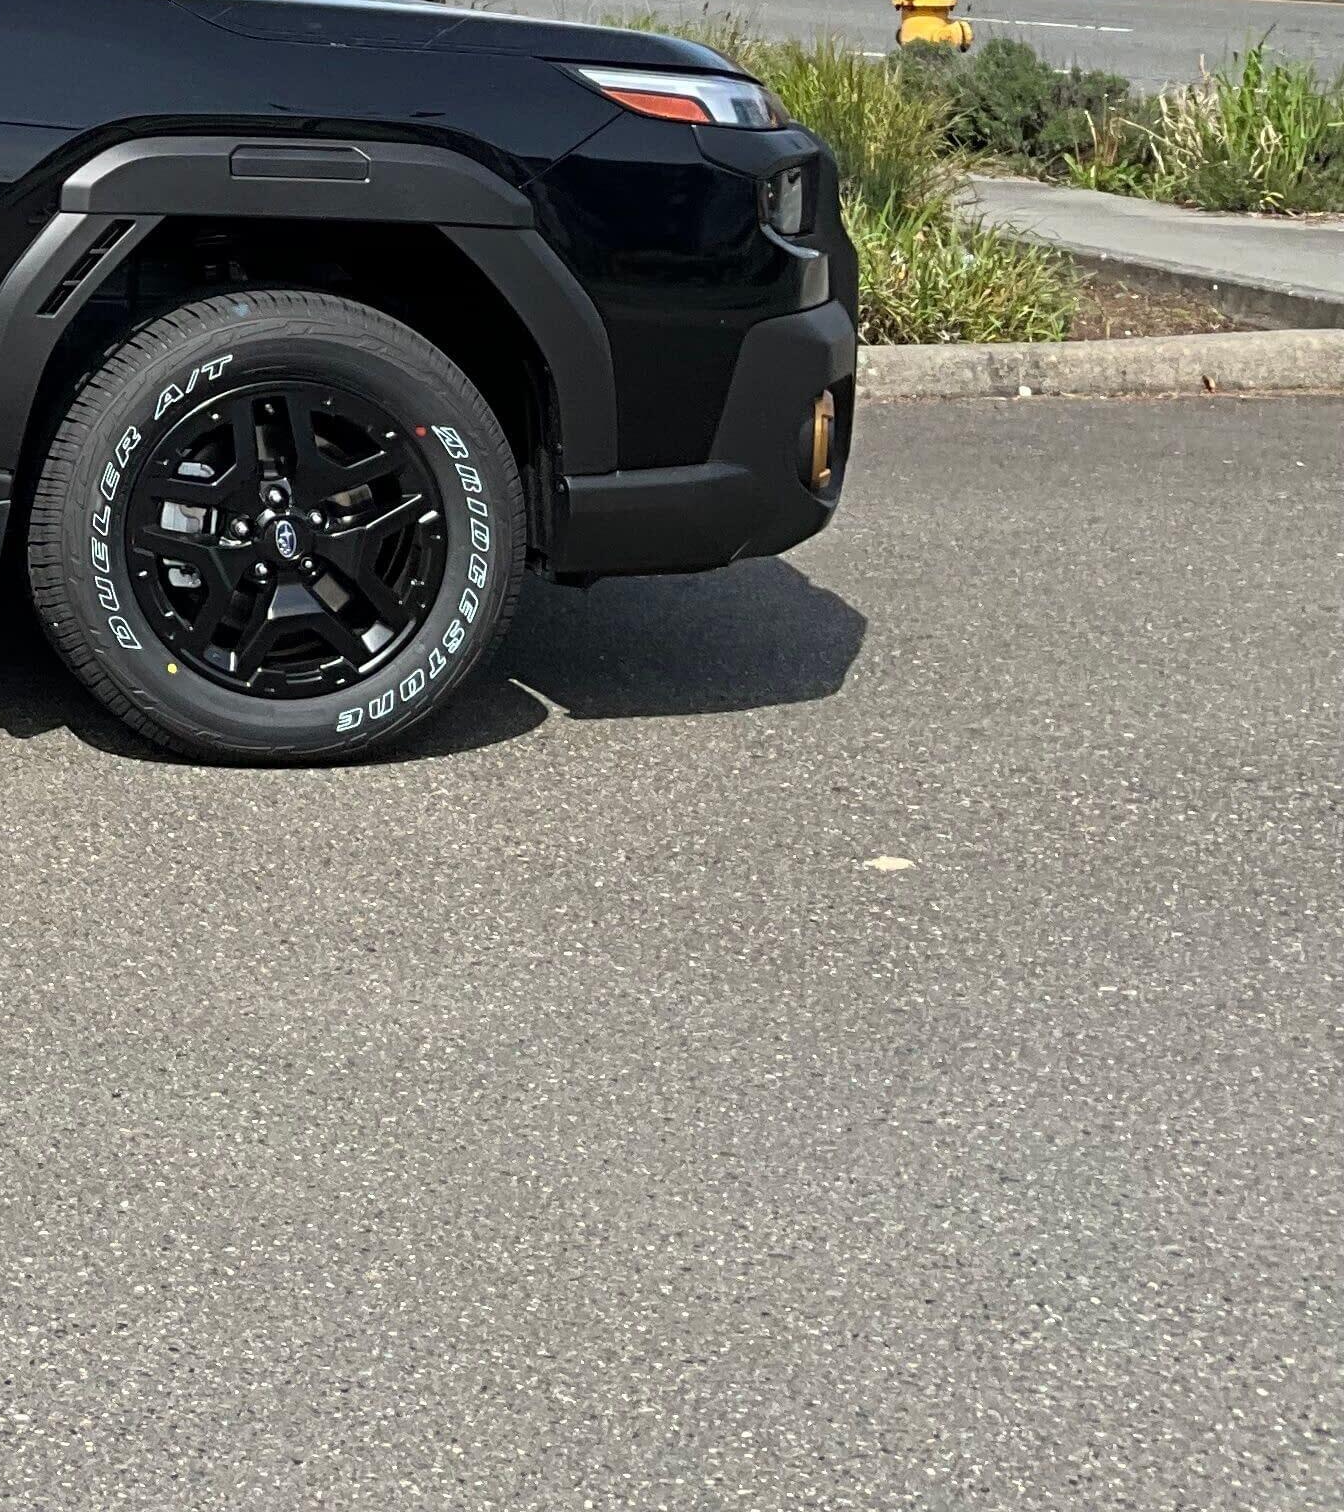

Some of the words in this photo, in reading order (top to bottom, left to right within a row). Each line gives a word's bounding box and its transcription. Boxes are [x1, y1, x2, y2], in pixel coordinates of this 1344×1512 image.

[91, 426, 142, 650] DUELER
[154, 355, 233, 419] A/T
[336, 425, 489, 732] BRIDGESTONE
